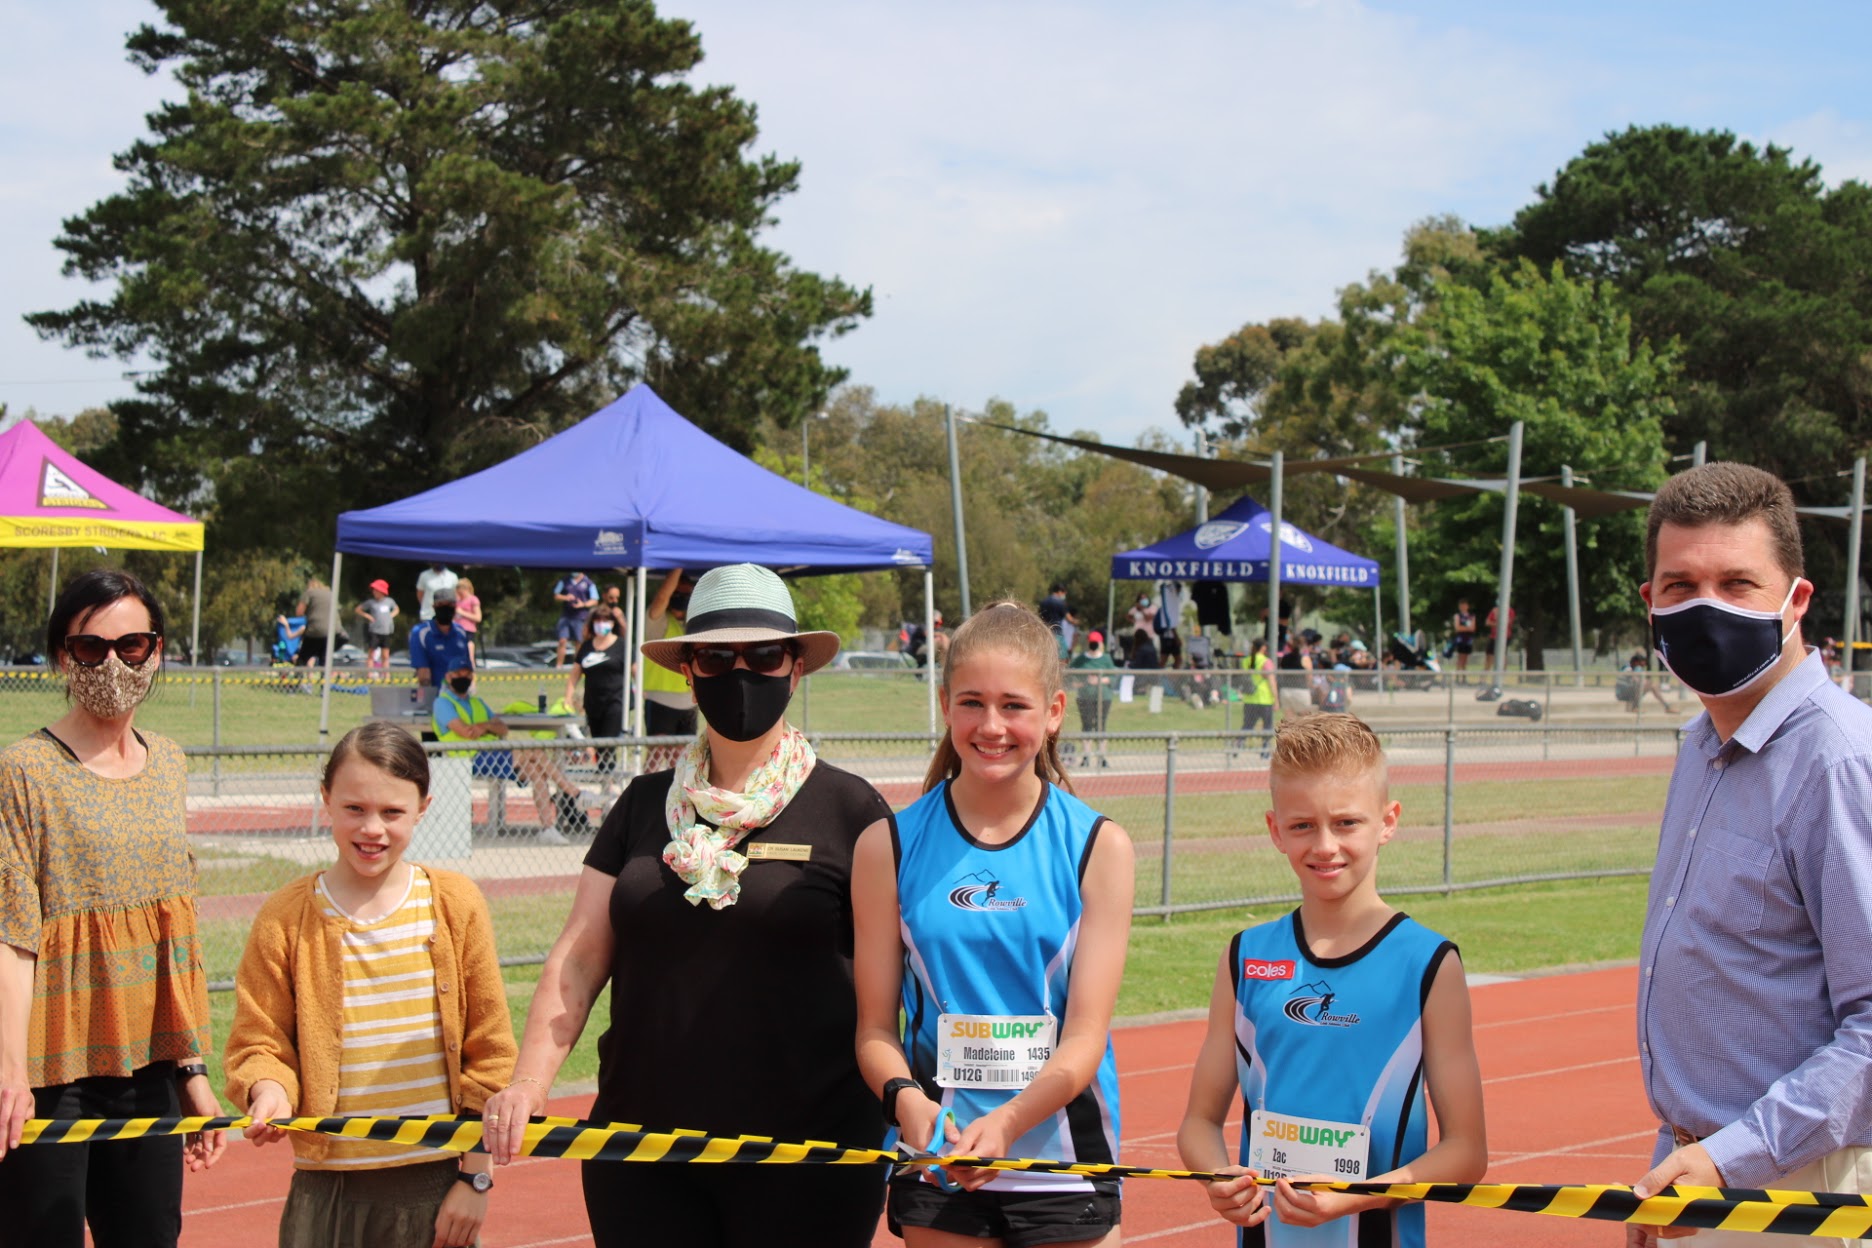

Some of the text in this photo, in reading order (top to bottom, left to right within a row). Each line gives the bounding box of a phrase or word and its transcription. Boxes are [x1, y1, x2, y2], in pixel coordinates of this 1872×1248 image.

[15, 526, 81, 538] SCORESBY
[1130, 561, 1253, 577] KNOXFIELD
[1286, 563, 1368, 582] KNOXFIELD
[988, 898, 1026, 907] Rowville
[1246, 964, 1286, 978] coles
[1321, 1012, 1360, 1024] Rowville
[950, 1021, 1044, 1039] SUBWAY
[963, 1047, 1050, 1061] Madeleine 1435
[953, 1068, 982, 1082] U12G
[1262, 1120, 1356, 1148] SUBWAY
[1272, 1148, 1361, 1175] Zac 1998
